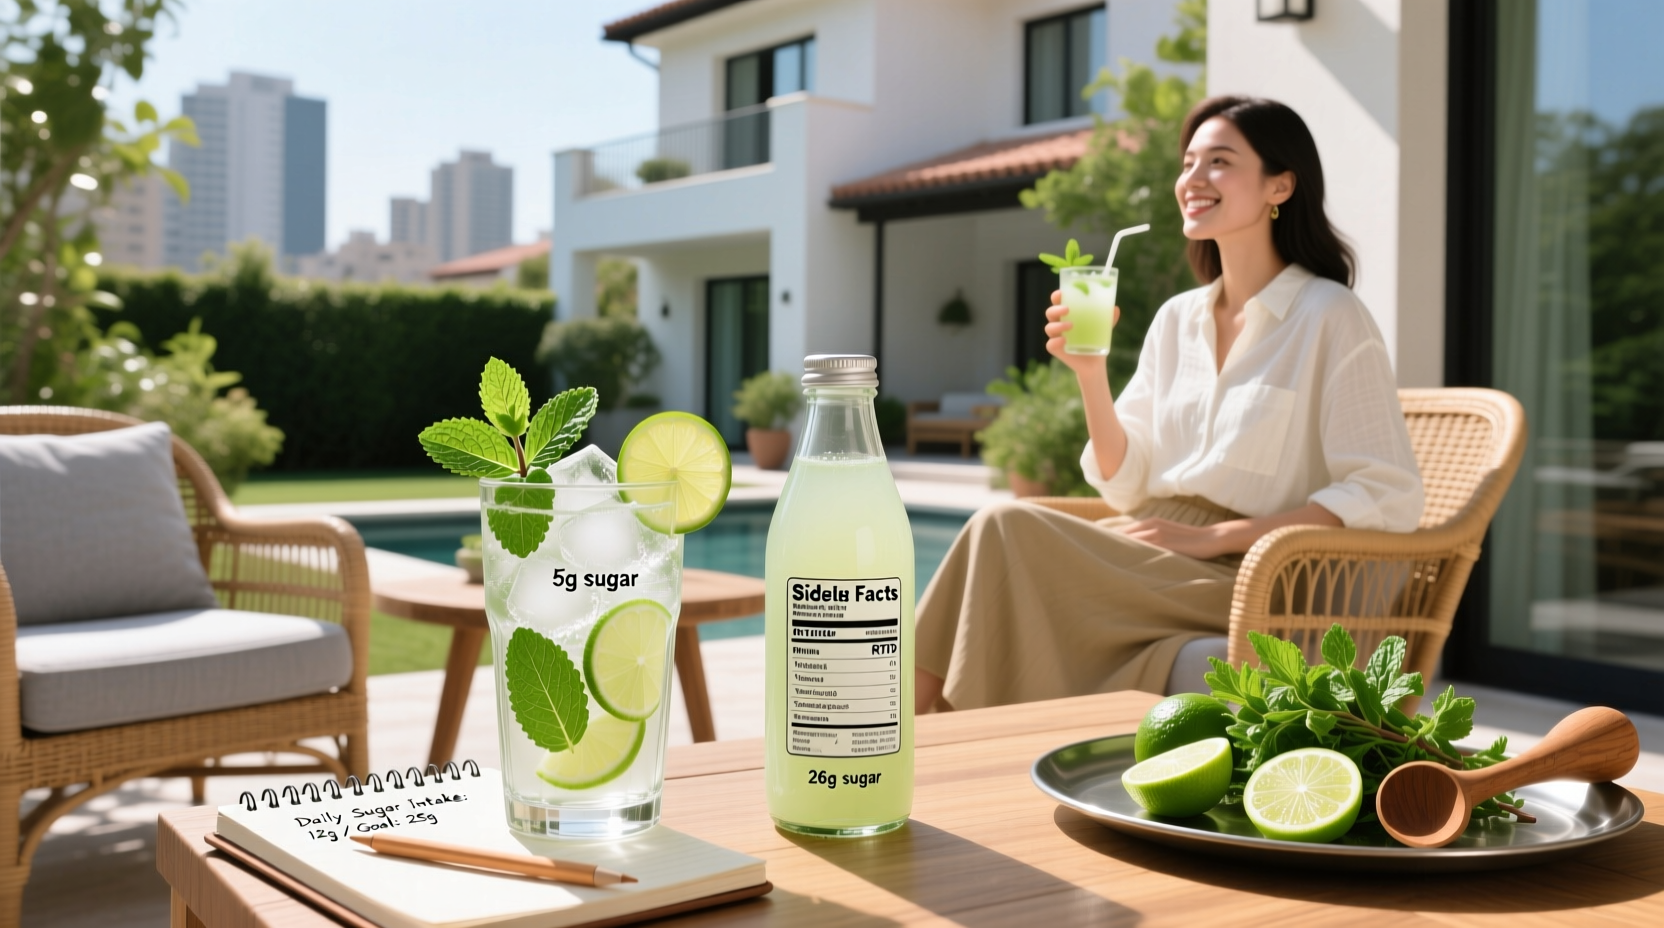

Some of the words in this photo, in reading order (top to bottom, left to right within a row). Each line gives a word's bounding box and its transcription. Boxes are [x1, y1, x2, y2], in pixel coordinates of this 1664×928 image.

[552, 568, 577, 592] 5g
[583, 573, 639, 592] sugar
[855, 585, 898, 602] Facts
[808, 769, 837, 789] 26g
[842, 772, 882, 788] sugar
[352, 804, 400, 818] Sugar
[407, 793, 468, 809] Intake:
[308, 829, 339, 842] 12g
[357, 815, 400, 832] Goal:
[406, 812, 438, 825] 25g
